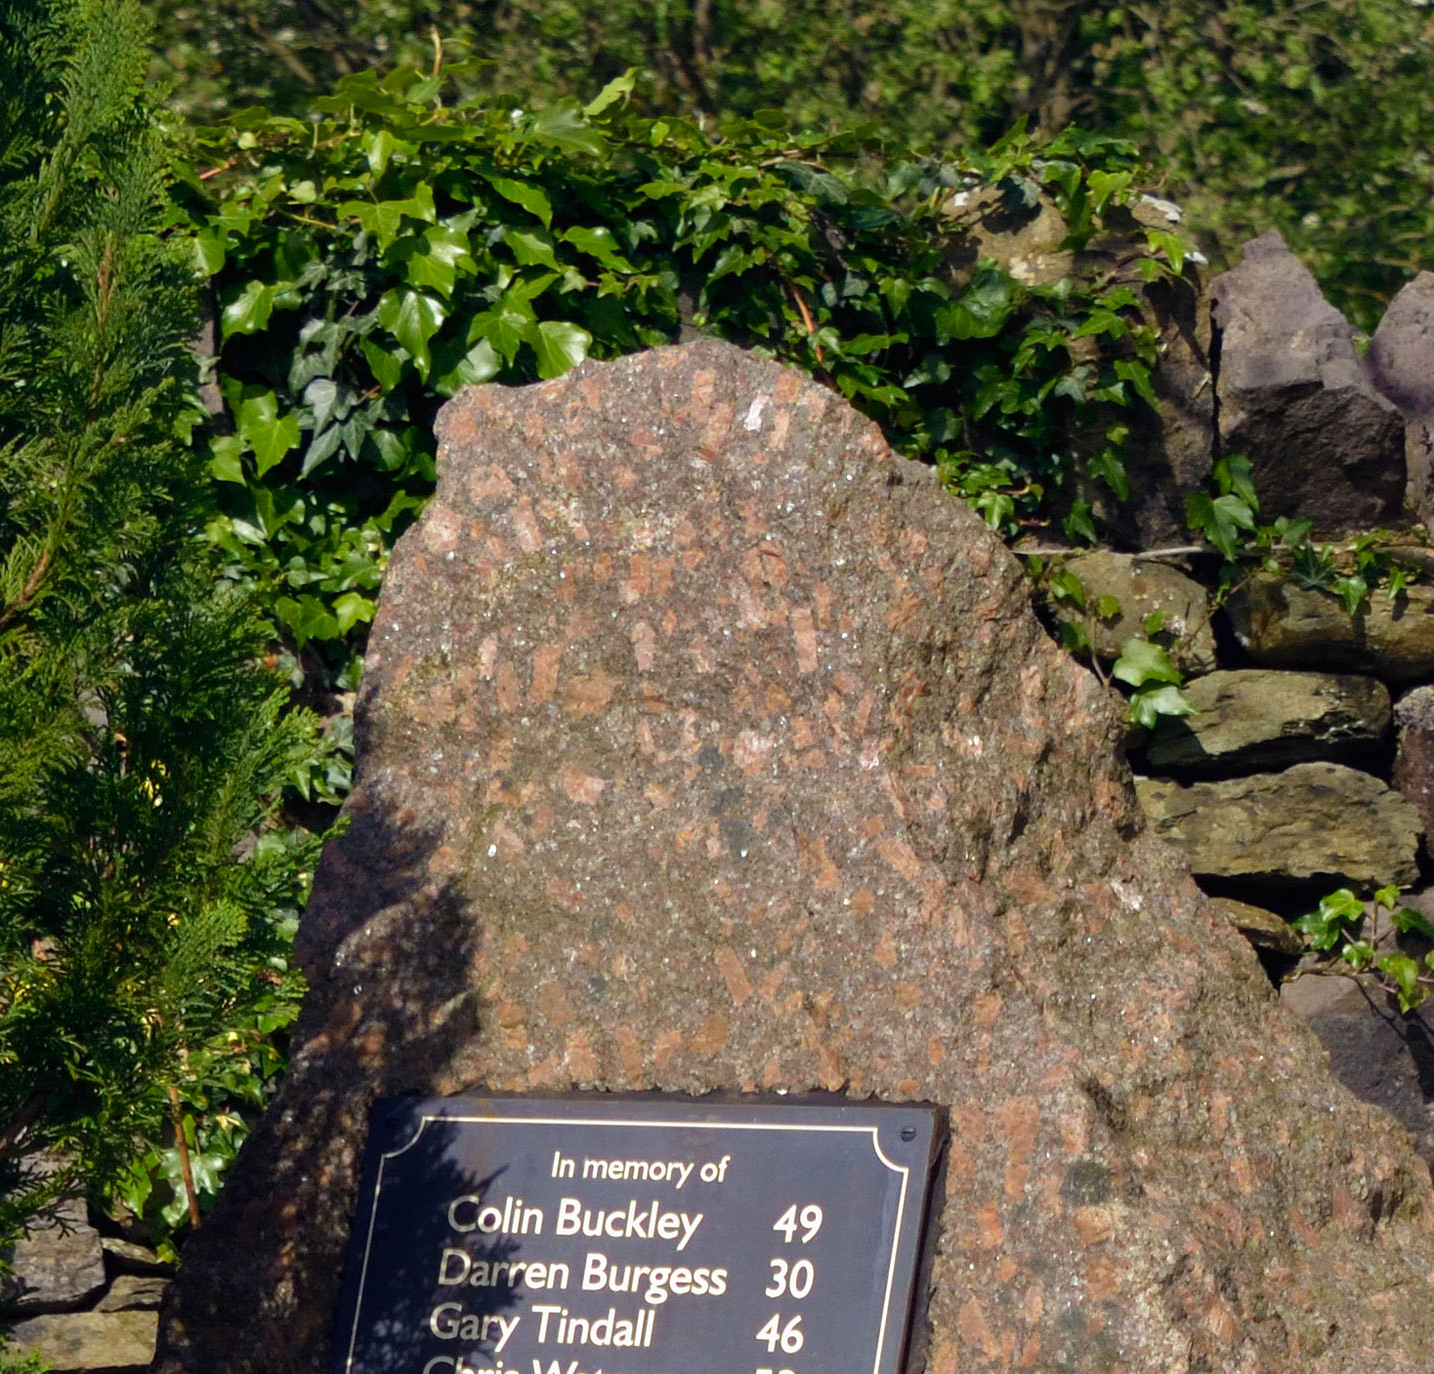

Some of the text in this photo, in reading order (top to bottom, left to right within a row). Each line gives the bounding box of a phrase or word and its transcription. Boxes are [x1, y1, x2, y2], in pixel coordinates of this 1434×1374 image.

[551, 1151, 732, 1190] In memory of
[447, 1193, 825, 1252] Colin Buckley 49
[436, 1248, 816, 1307] Darren Burgess 30
[429, 1302, 805, 1354] Gary Tindall 46
